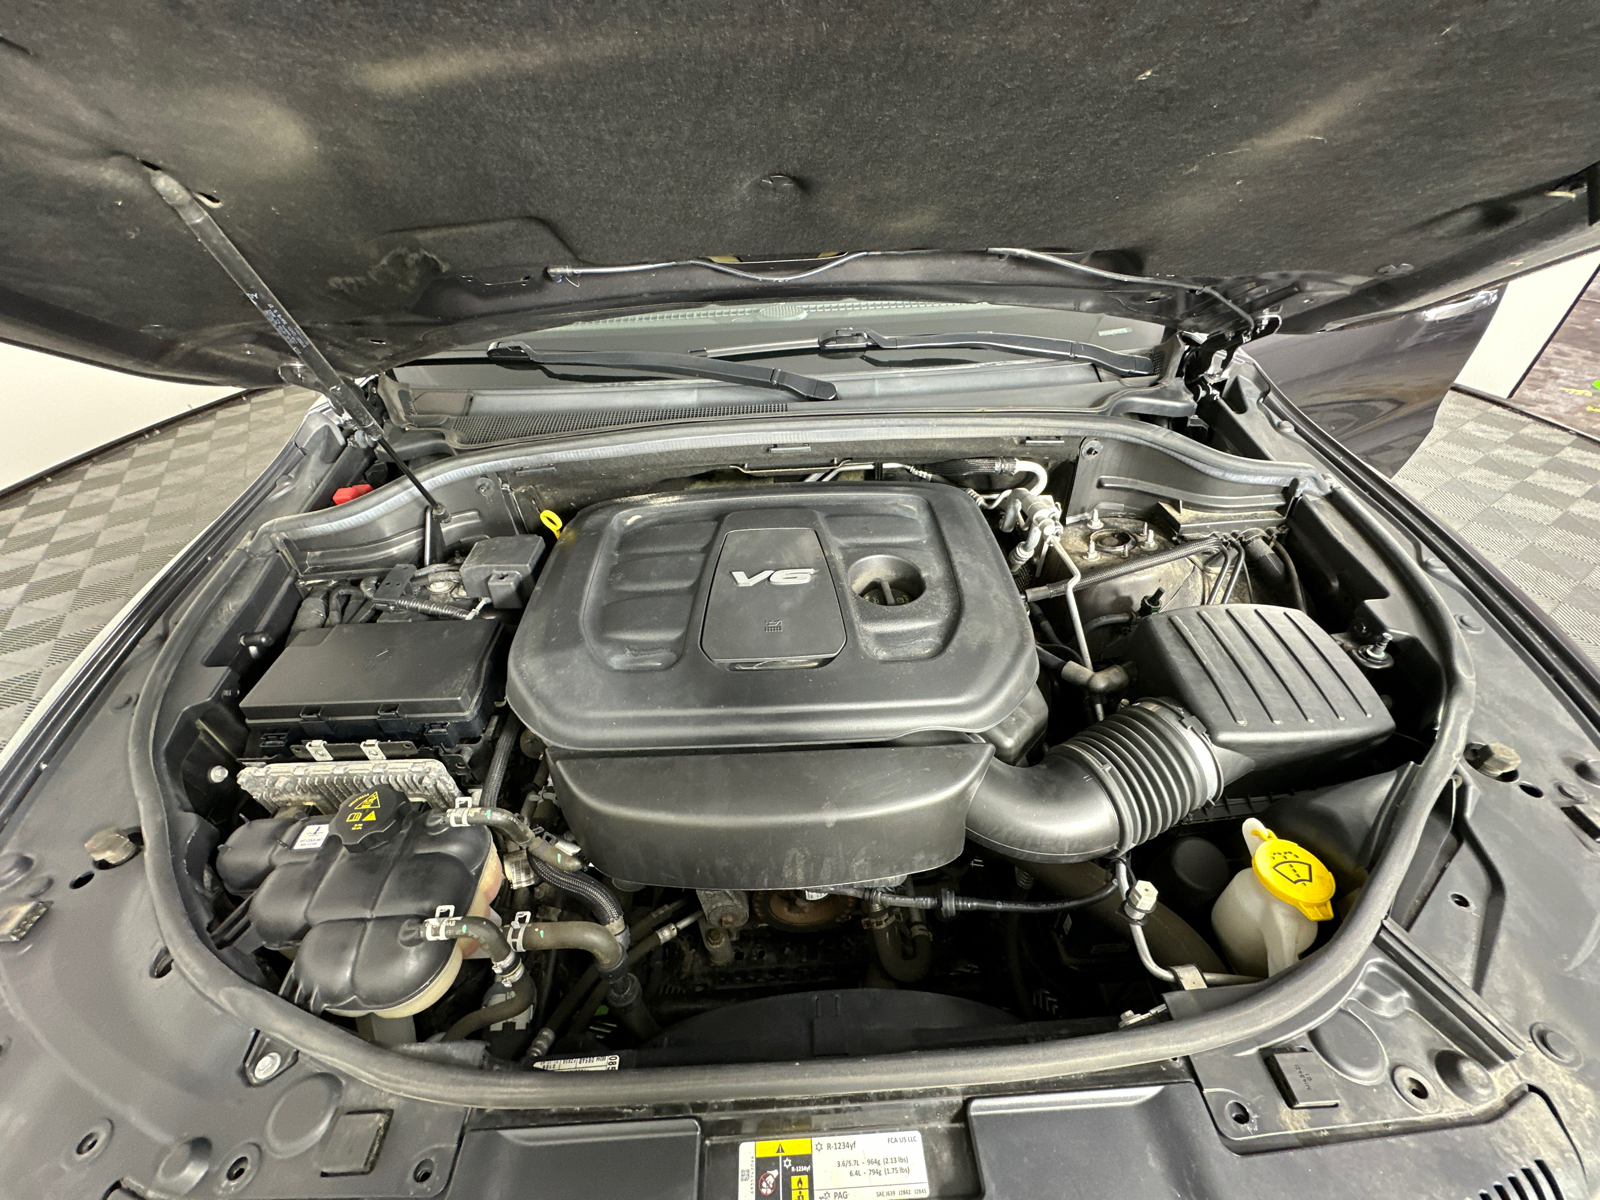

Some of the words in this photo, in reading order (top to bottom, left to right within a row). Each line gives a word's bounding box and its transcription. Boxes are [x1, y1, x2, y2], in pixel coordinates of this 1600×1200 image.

[731, 568, 815, 587] V6
[827, 1141, 856, 1151] R-1234yf
[837, 1159, 860, 1168] 3.6/5.7L
[867, 1158, 881, 1166] 964g
[883, 1157, 898, 1165] (2.13
[898, 1156, 909, 1164] lbs)
[868, 1169, 882, 1177] 794g
[884, 1167, 899, 1176] (1.75
[899, 1166, 910, 1174] lbs)
